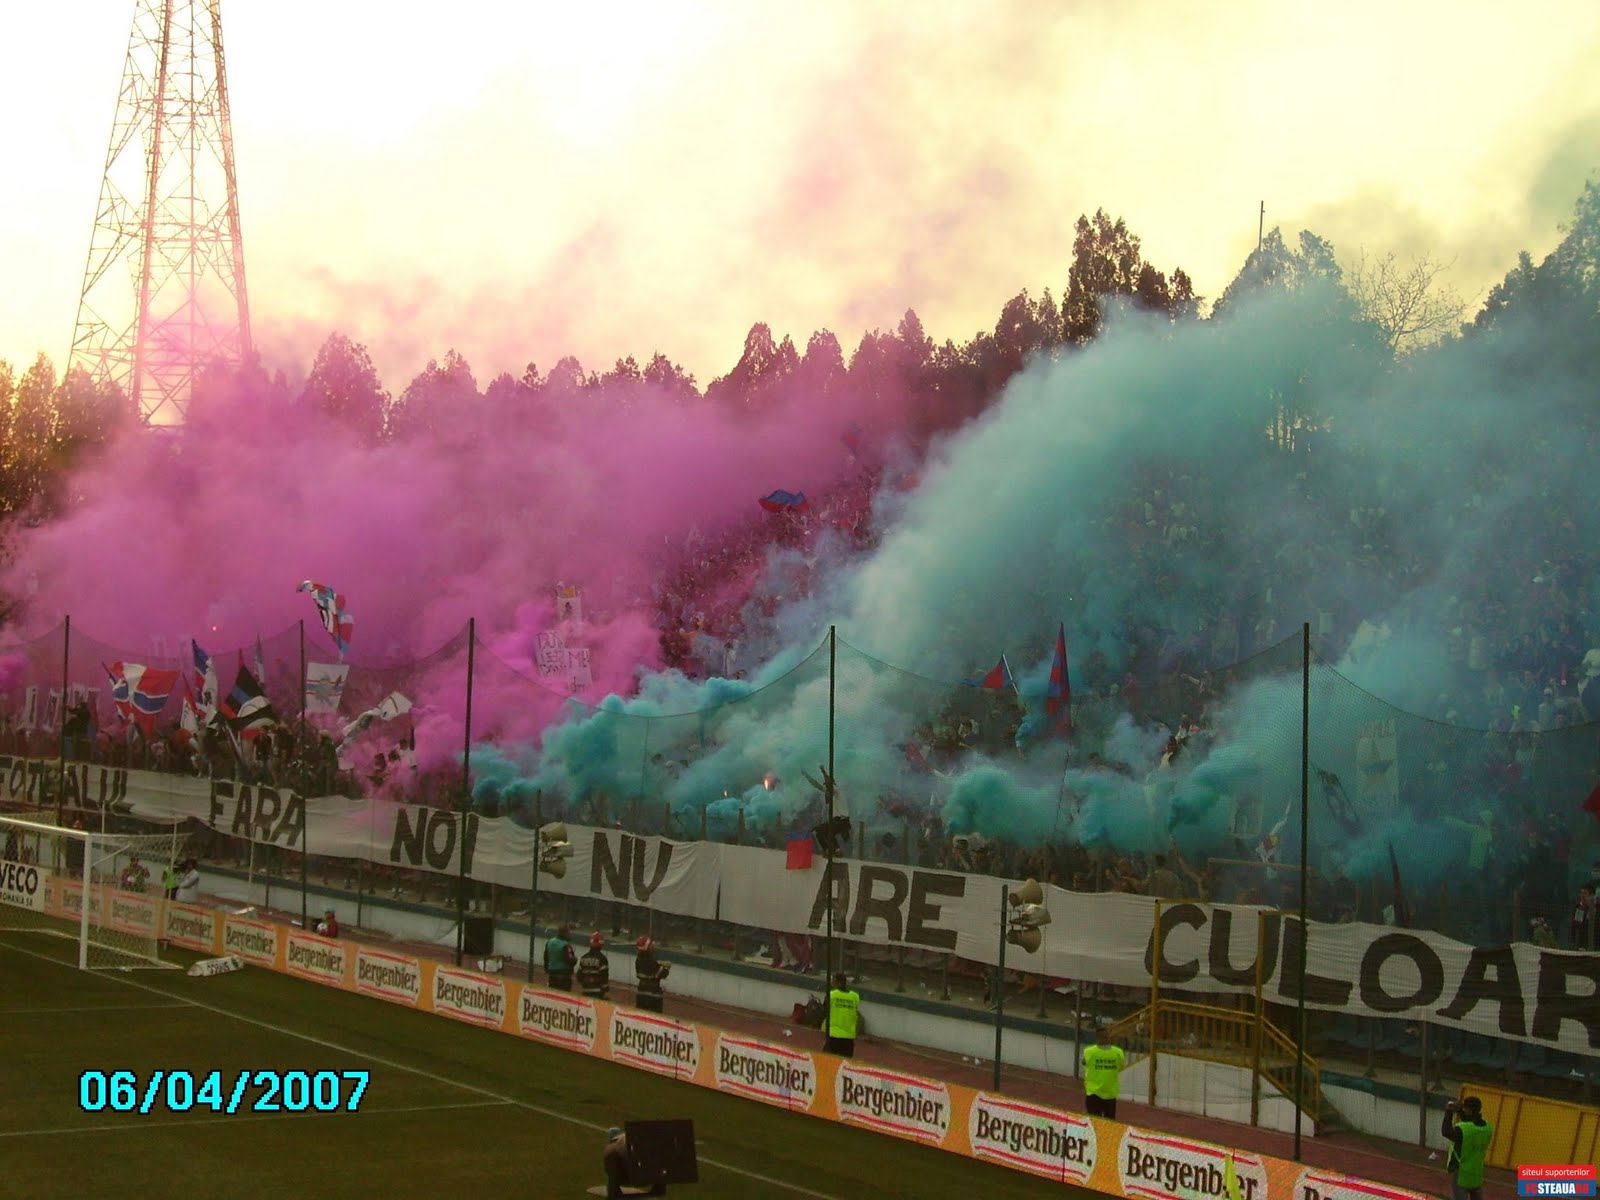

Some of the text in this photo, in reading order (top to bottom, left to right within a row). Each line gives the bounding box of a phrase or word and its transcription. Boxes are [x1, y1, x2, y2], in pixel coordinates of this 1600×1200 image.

[208, 779, 305, 847] FARA
[390, 807, 479, 875] NOI
[590, 832, 673, 902] NU
[808, 862, 966, 950] ARE
